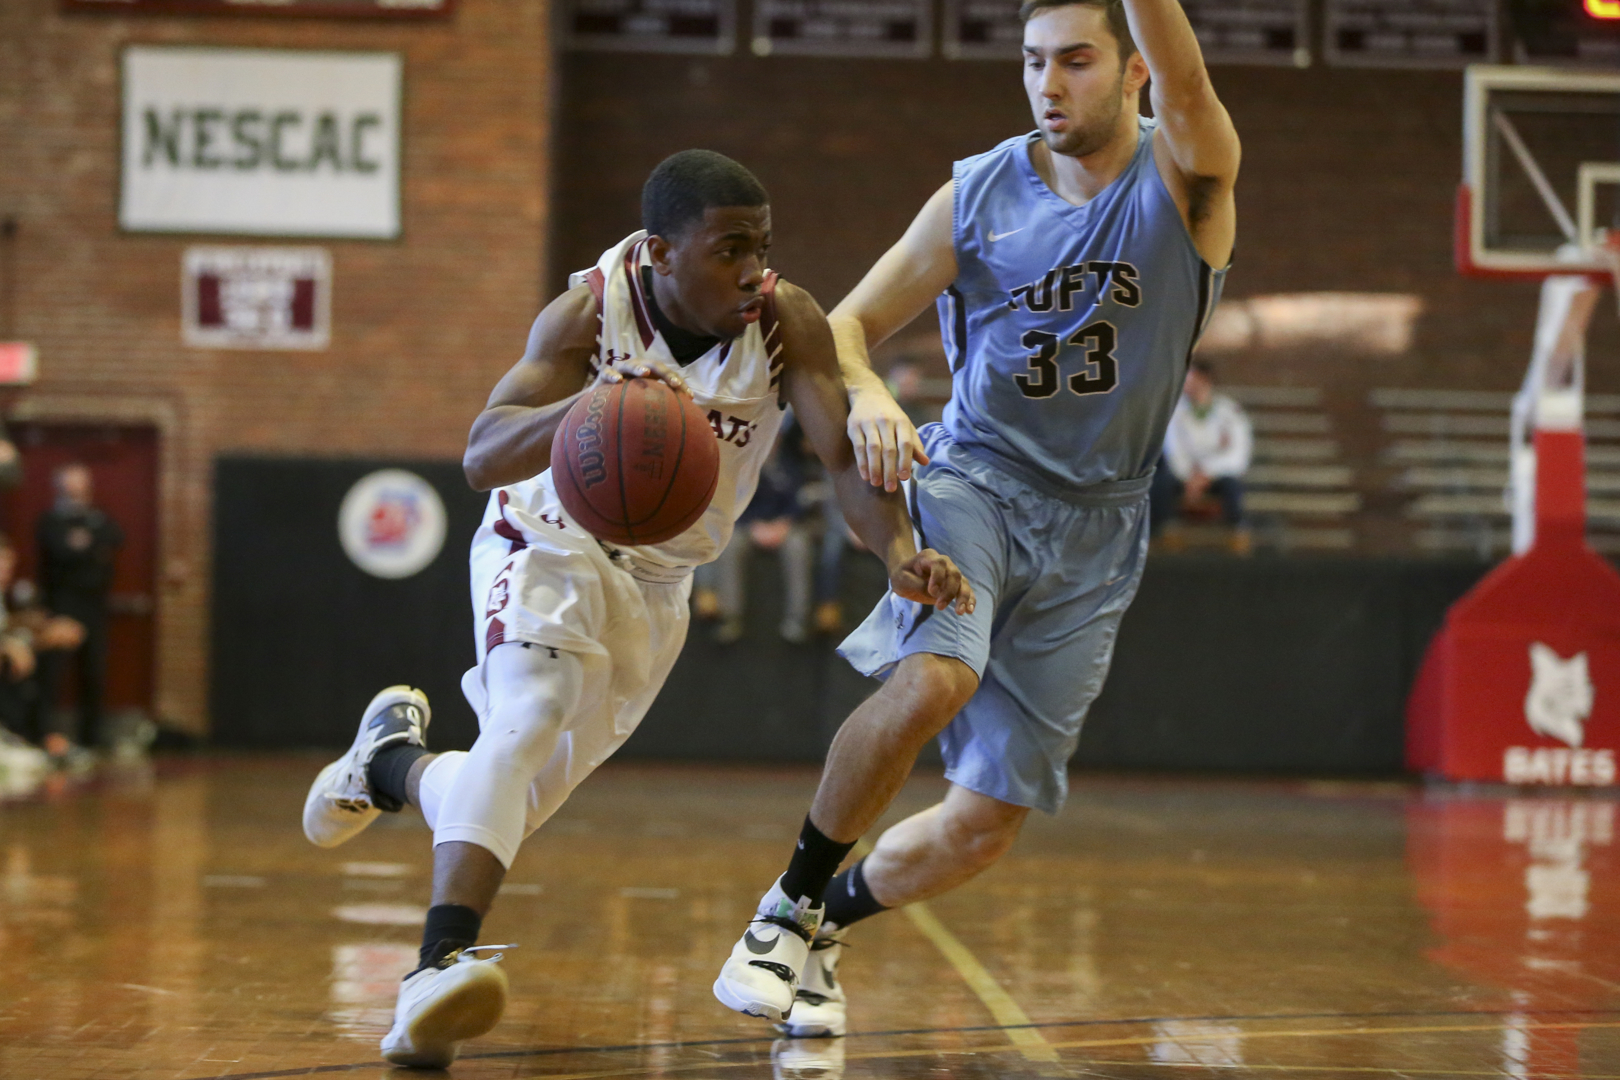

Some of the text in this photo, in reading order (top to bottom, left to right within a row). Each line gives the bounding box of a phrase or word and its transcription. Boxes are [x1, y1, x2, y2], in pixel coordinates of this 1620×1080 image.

[141, 106, 383, 174] NESCAC
[1013, 320, 1120, 399] 33
[707, 409, 758, 448] ATS
[1503, 745, 1617, 787] BATES
